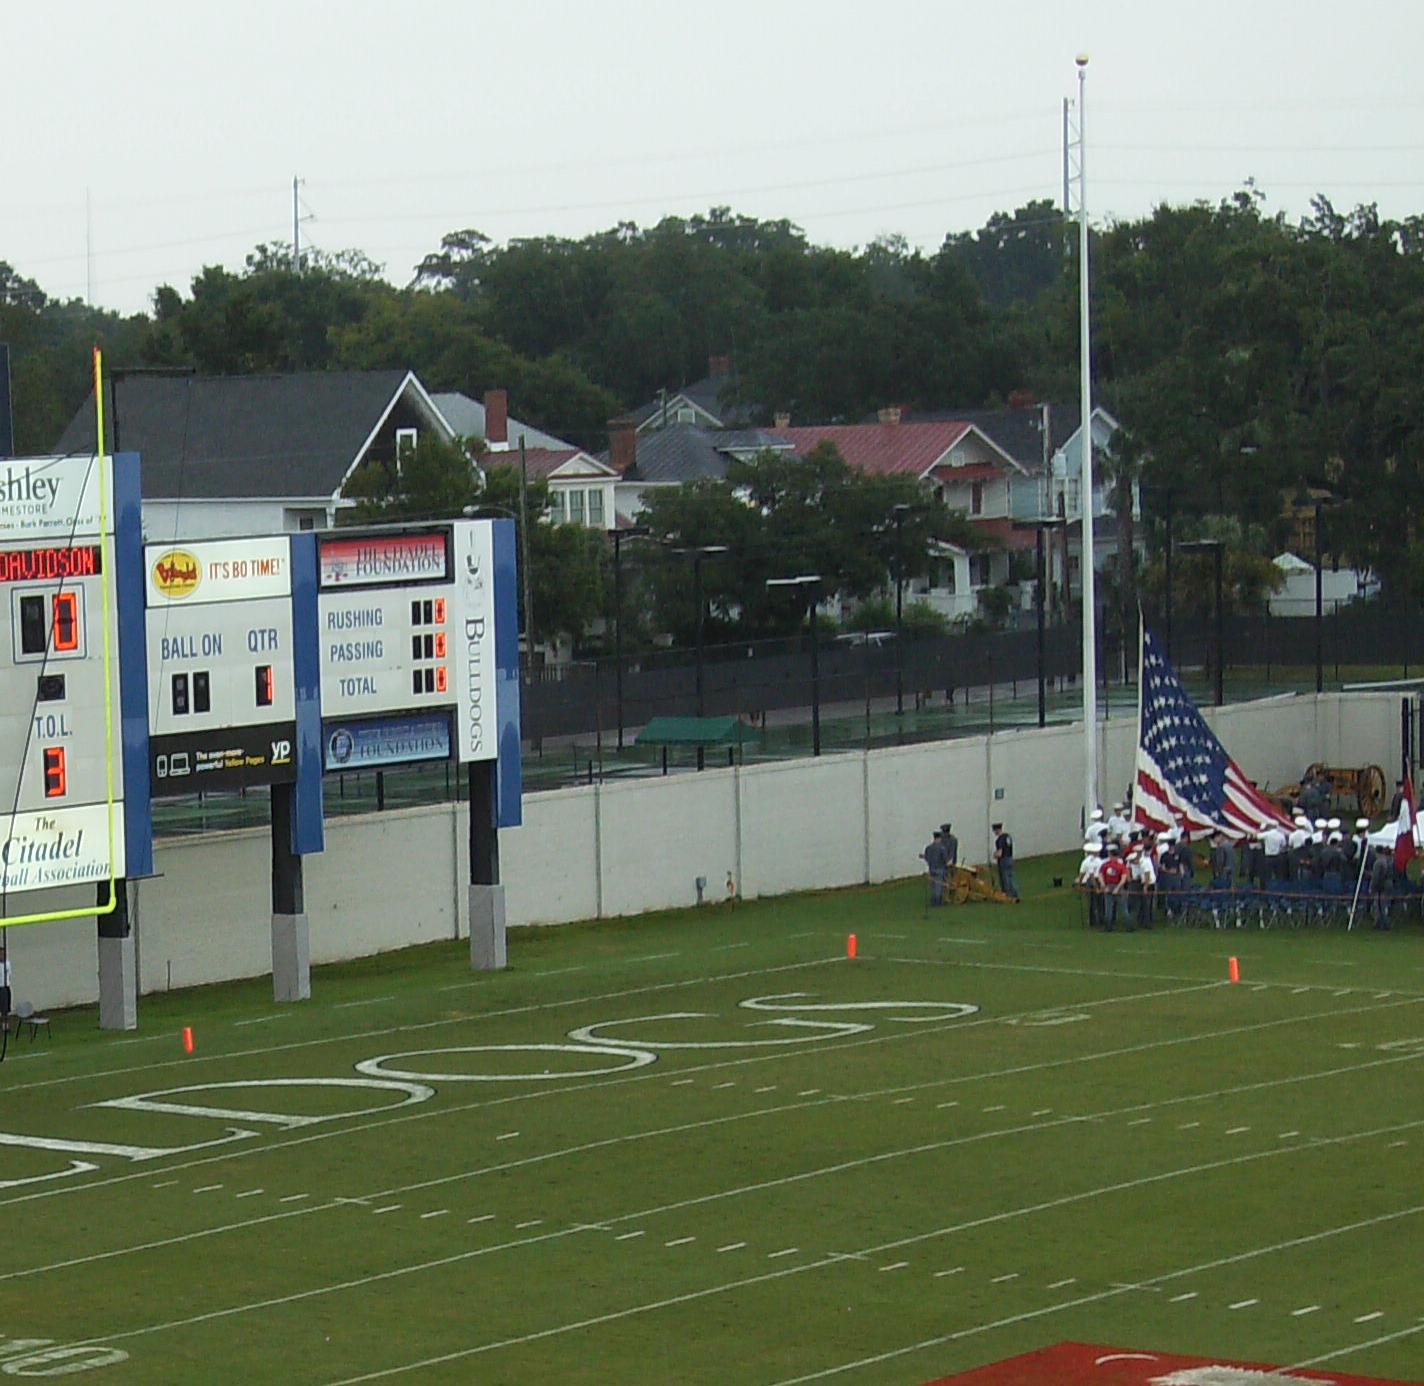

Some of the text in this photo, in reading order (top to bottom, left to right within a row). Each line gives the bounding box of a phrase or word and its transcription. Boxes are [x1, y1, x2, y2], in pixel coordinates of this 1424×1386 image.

[209, 562, 229, 580] IT'S
[232, 560, 247, 578] BO
[250, 558, 280, 576] TIME!
[356, 557, 440, 576] FOUNDATION
[53, 593, 78, 650] 0
[328, 608, 383, 630] RUSHING
[435, 598, 445, 624] 0
[161, 634, 222, 660] BALL ON
[248, 629, 278, 653] QTR
[331, 640, 383, 663] PASSING
[436, 632, 445, 658] 0
[340, 677, 377, 697] TOTAL
[436, 666, 446, 692] 0
[465, 617, 485, 752] BULLDOGS
[35, 714, 73, 738] T.O.L.
[271, 741, 290, 760] yp
[46, 747, 64, 796] 3
[35, 817, 56, 832] The
[2, 829, 83, 866] Citadel
[34, 859, 111, 884] Association
